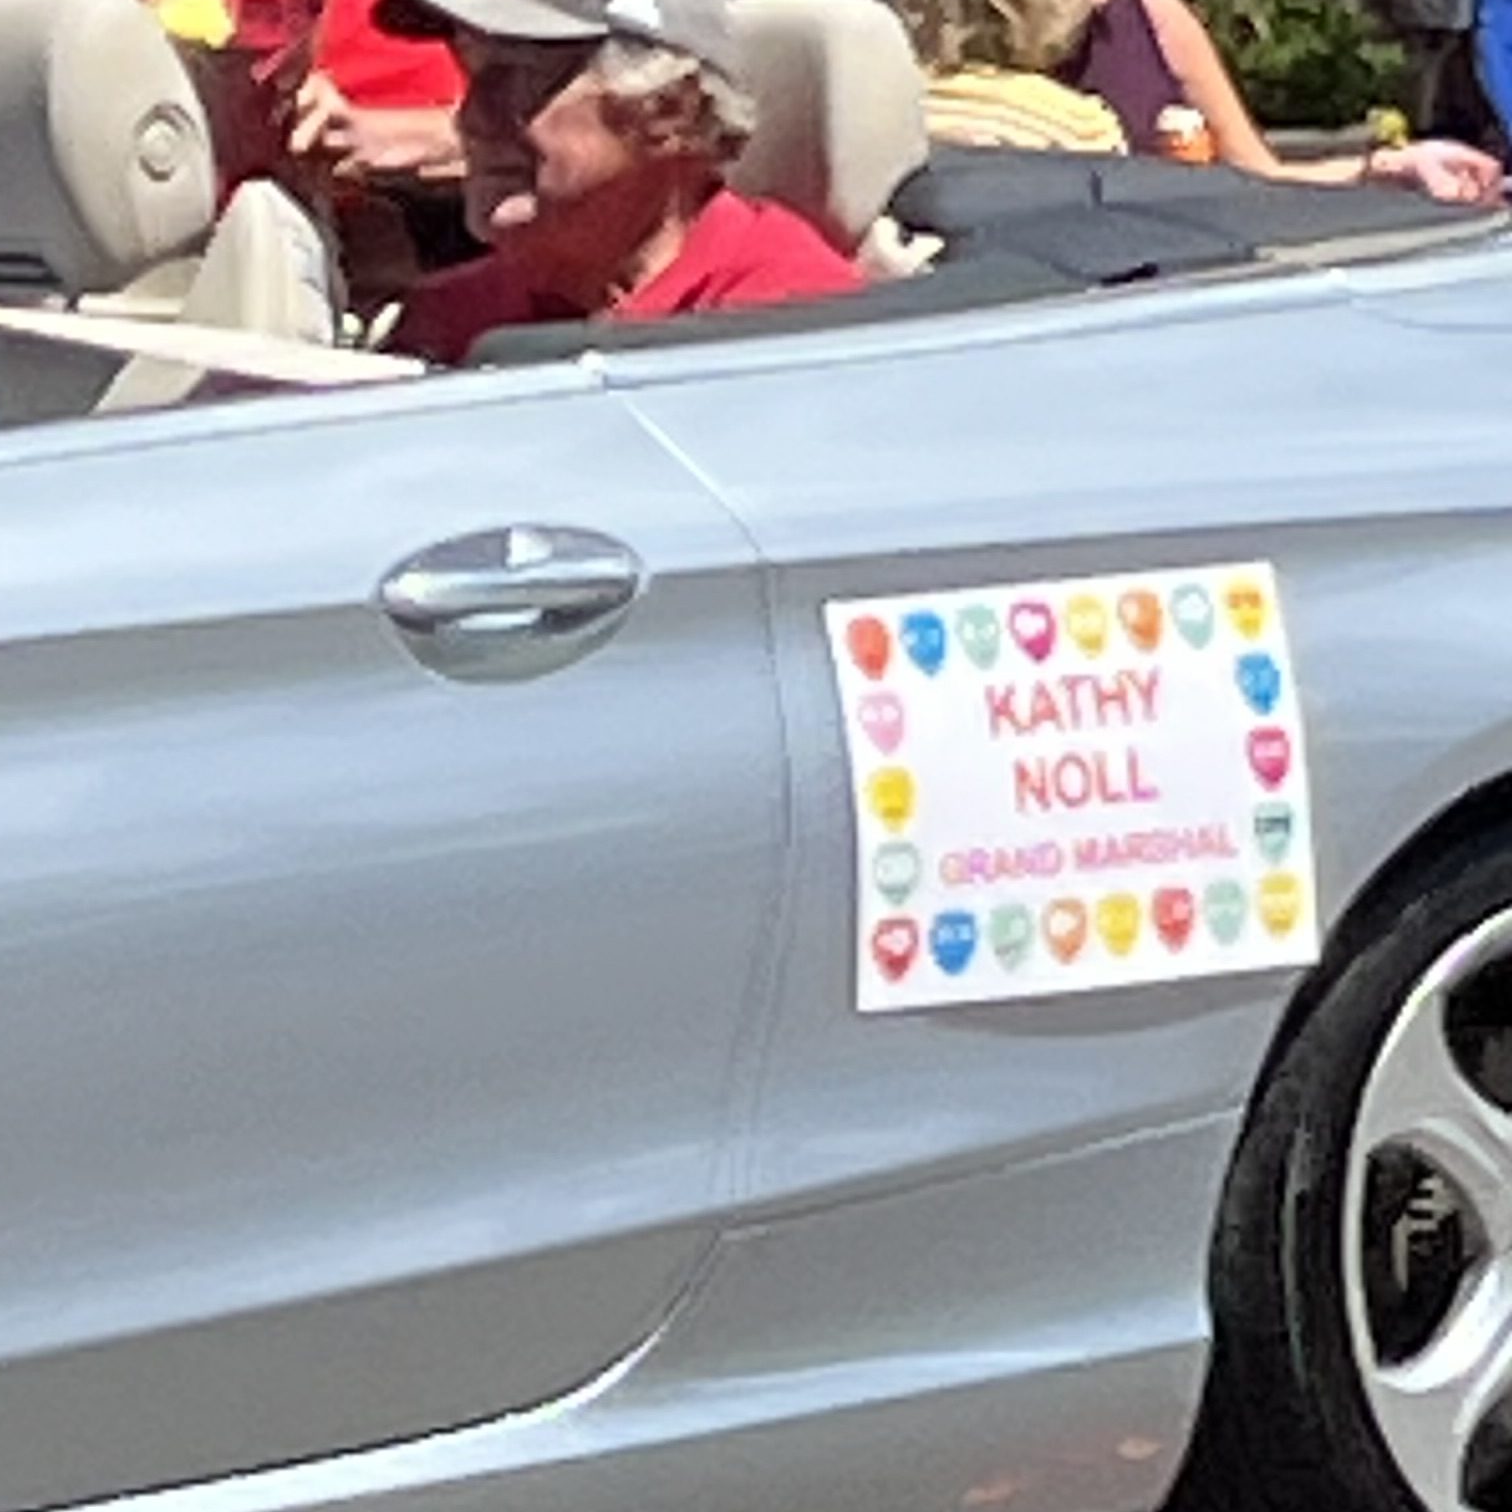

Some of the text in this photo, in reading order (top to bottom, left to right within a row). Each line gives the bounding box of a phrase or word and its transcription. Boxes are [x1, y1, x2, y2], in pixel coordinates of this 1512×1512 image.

[984, 666, 1161, 739] KATHY
[1012, 746, 1159, 813] NOLL
[939, 823, 1237, 885] GRAND MARSHAL
